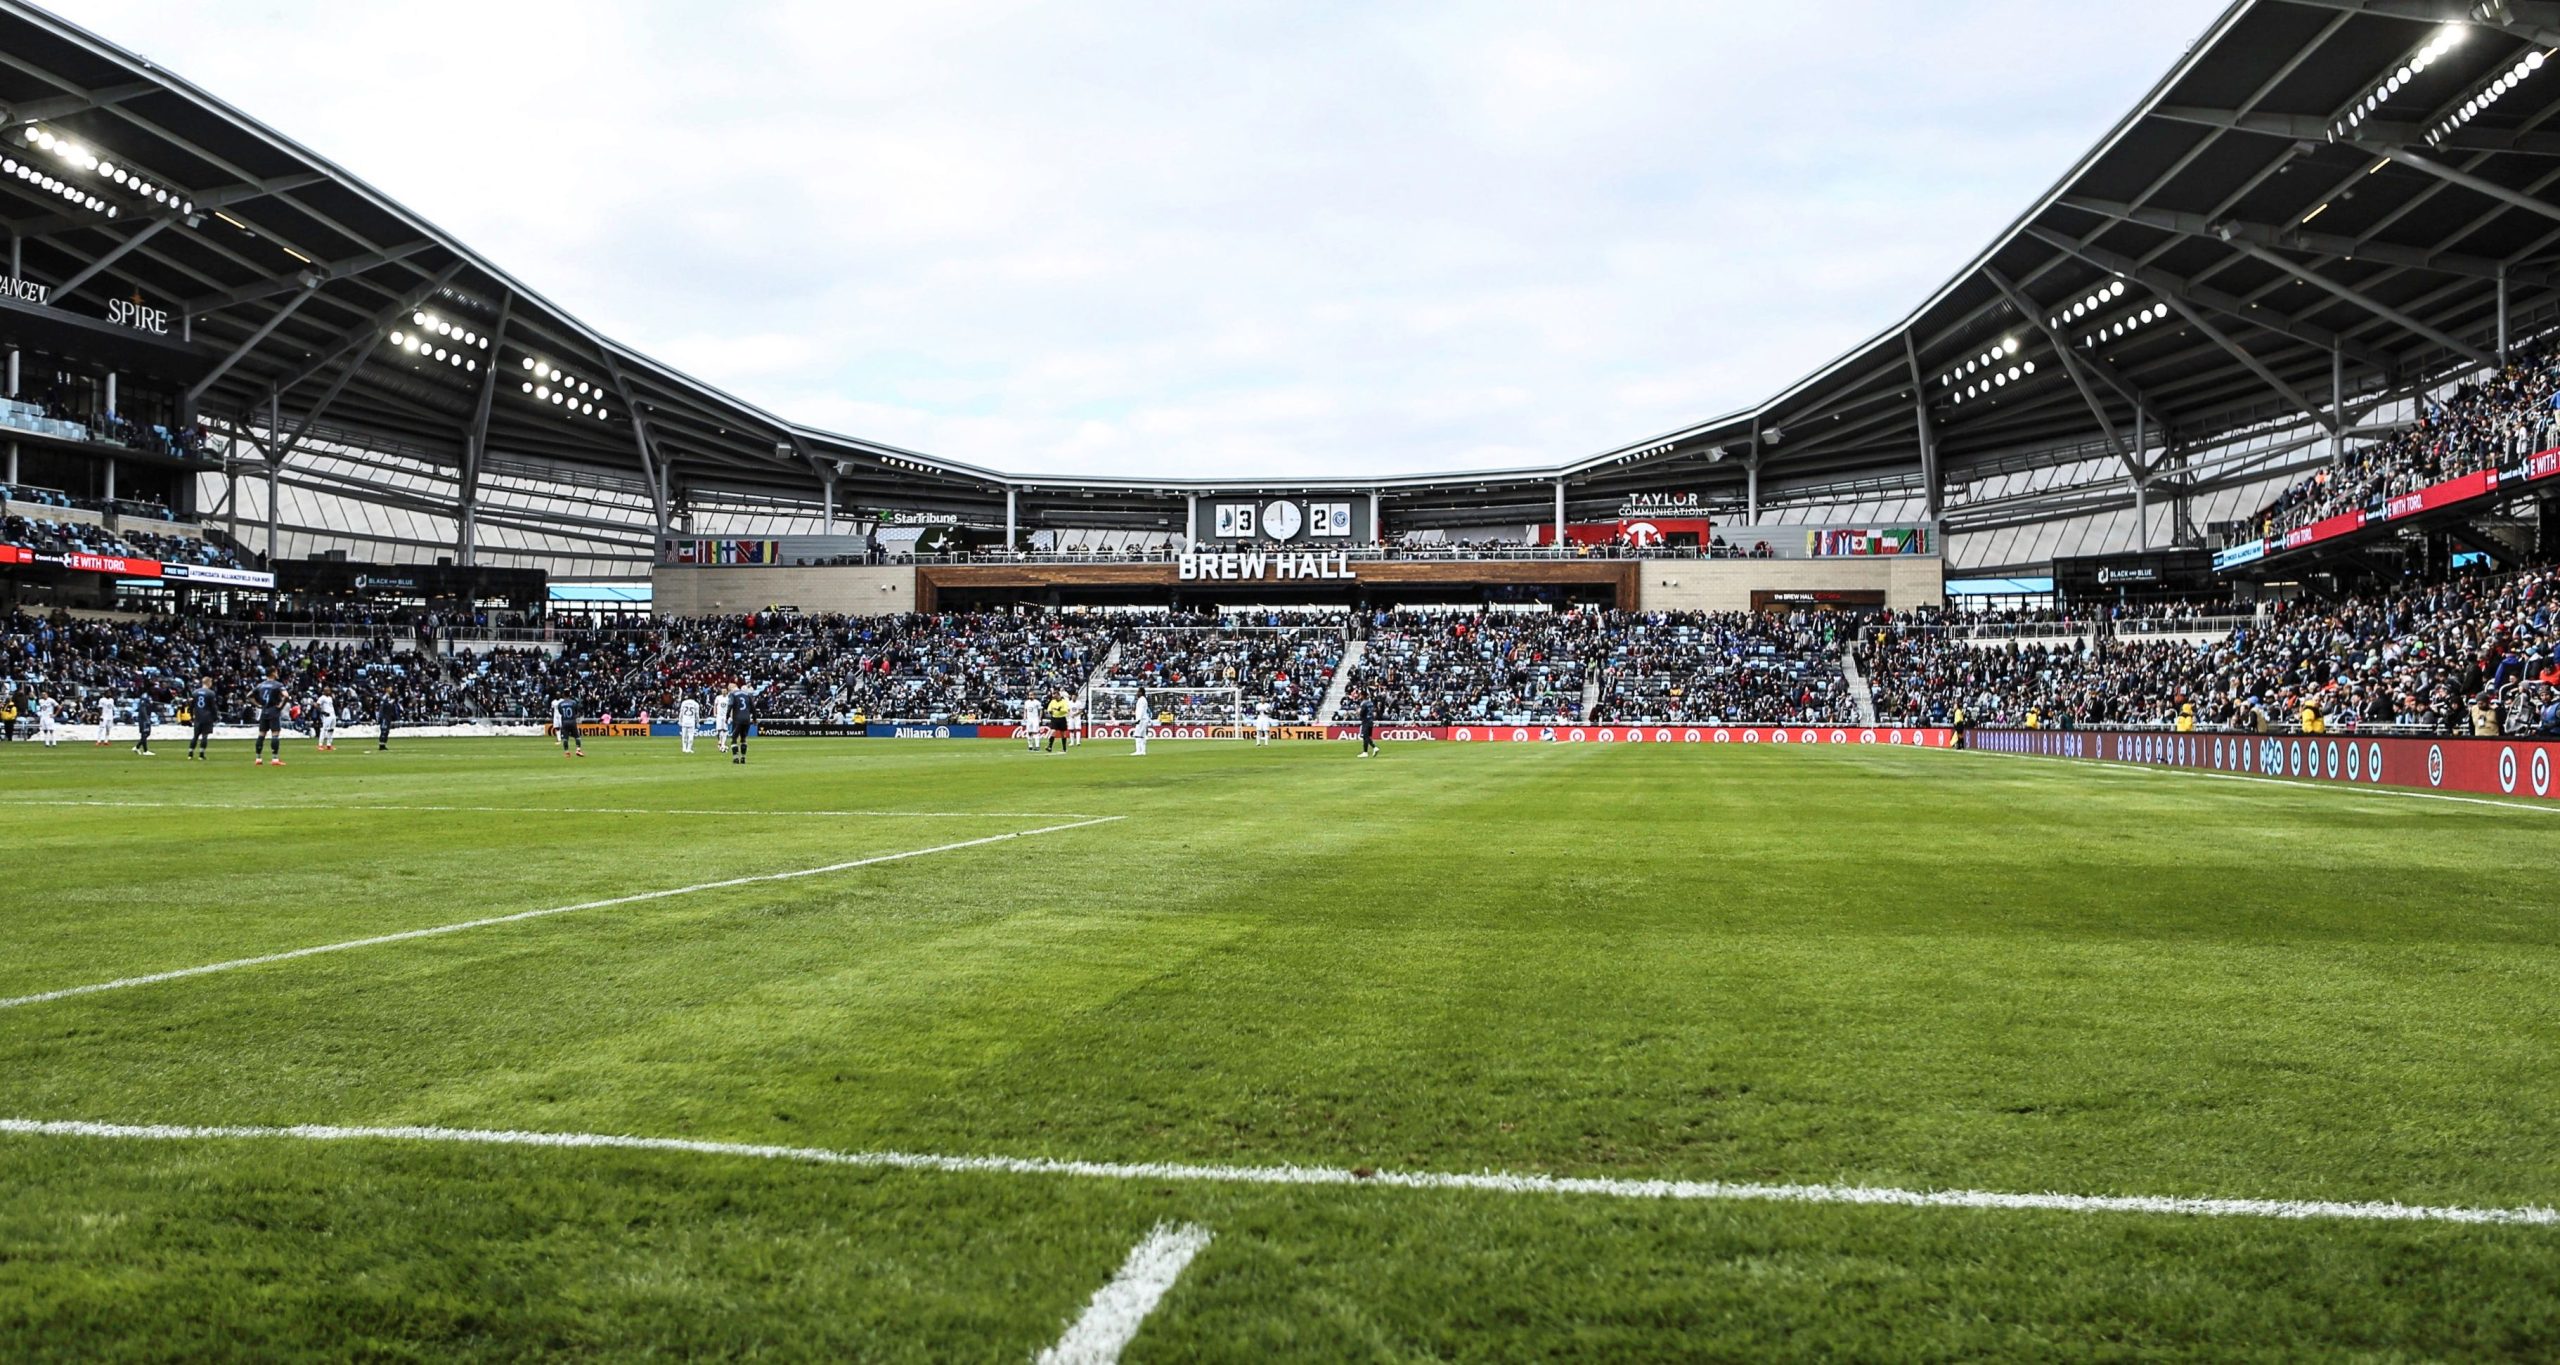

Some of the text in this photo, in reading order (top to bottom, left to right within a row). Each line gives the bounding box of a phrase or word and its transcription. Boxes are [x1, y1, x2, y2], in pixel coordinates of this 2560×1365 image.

[0, 275, 39, 302] ANCE
[109, 299, 168, 334] SPIRE
[1301, 499, 1309, 508] 2
[1629, 493, 1698, 507] TAYLOR
[1618, 507, 1709, 517] COMMUNICATIONS
[894, 513, 957, 525] StarTribune
[1239, 510, 1252, 531] 3
[1313, 509, 1327, 530] 2
[80, 558, 102, 569] WITH
[103, 559, 127, 572] TORO.
[1179, 552, 1356, 580] BREW HALL
[2138, 568, 2153, 576] BLUE
[197, 696, 205, 708] 8
[739, 697, 747, 711] 3
[562, 707, 573, 718] 10
[683, 706, 694, 717] 25
[622, 728, 647, 737] TIRE
[895, 727, 933, 739] Allianz
[1296, 731, 1323, 740] TIRE
